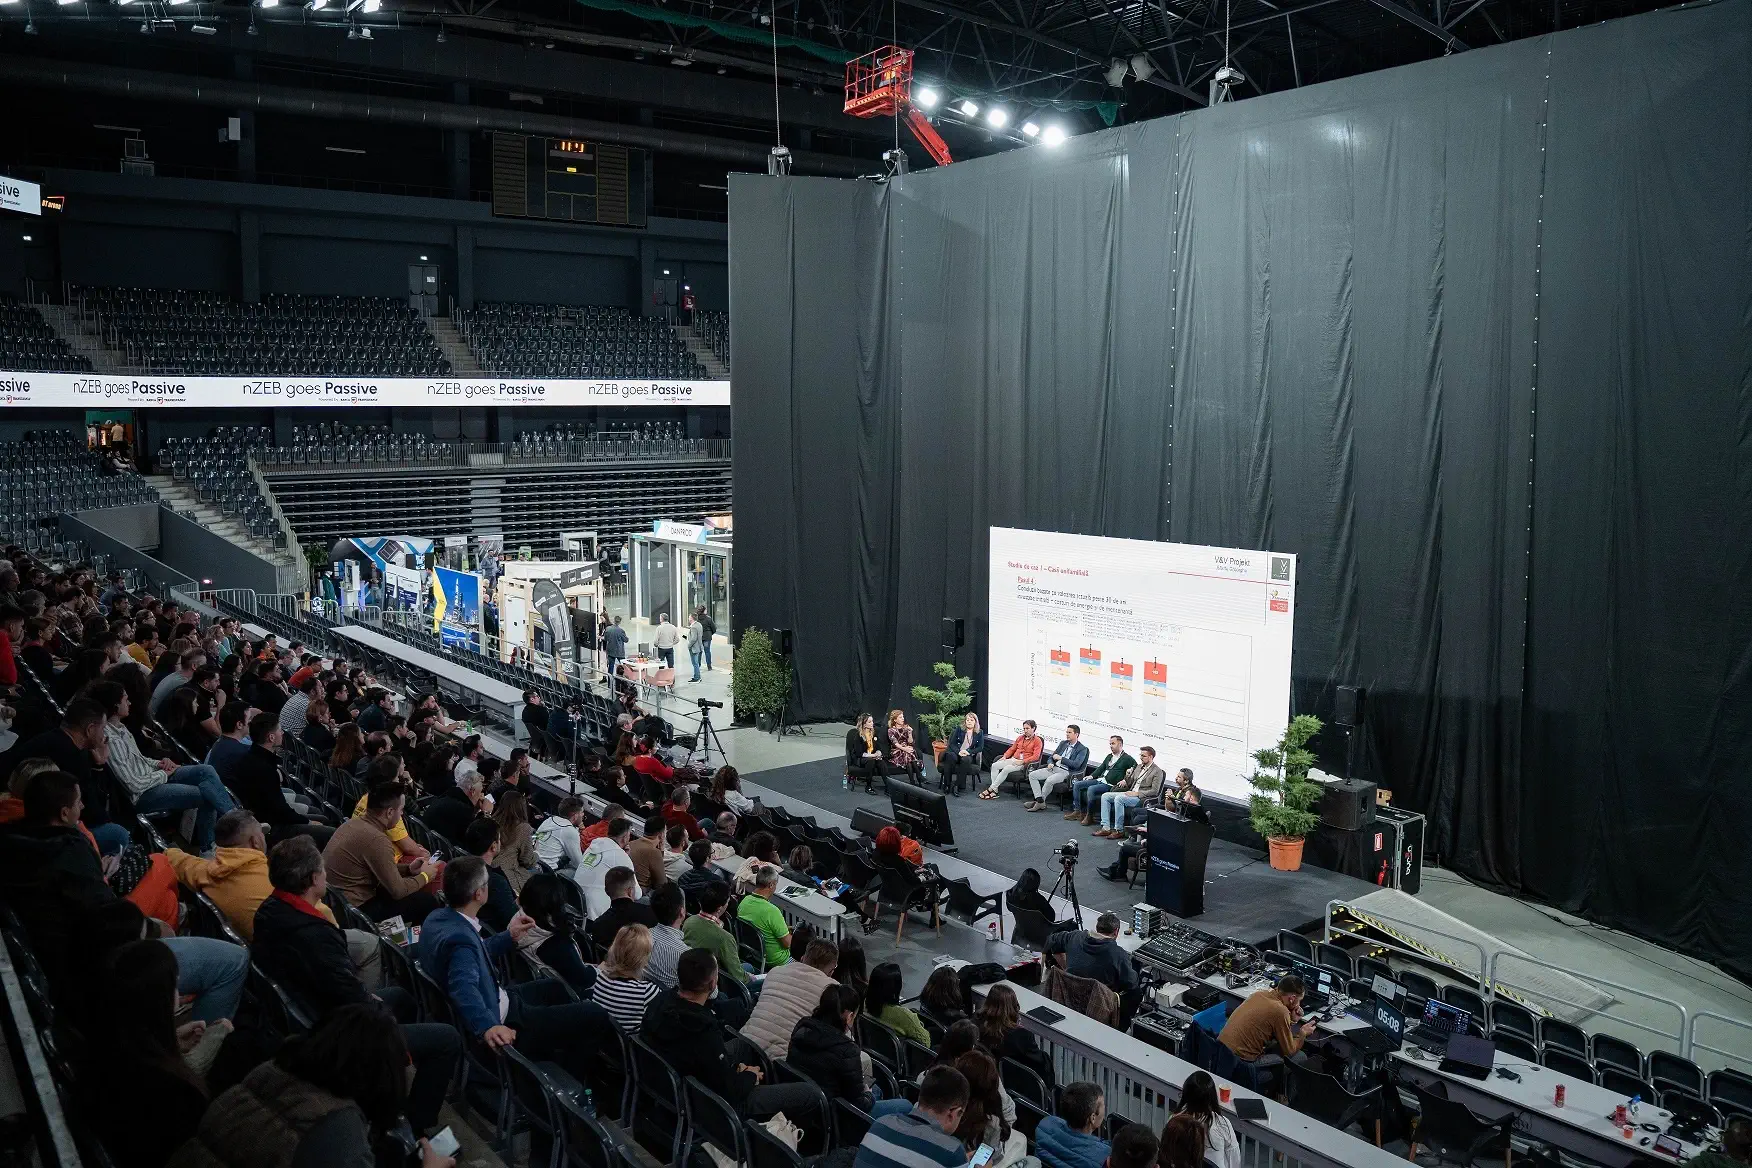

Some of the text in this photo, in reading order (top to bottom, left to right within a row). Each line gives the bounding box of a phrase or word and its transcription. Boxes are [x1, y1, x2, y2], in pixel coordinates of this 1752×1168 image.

[73, 379, 186, 398] nZEB goes Passive
[243, 381, 378, 398] nZEB goes Passive
[427, 382, 545, 398] nZEB goes Passive
[588, 383, 693, 398] nZEB goes Passive
[1377, 1007, 1400, 1033] 05:08
